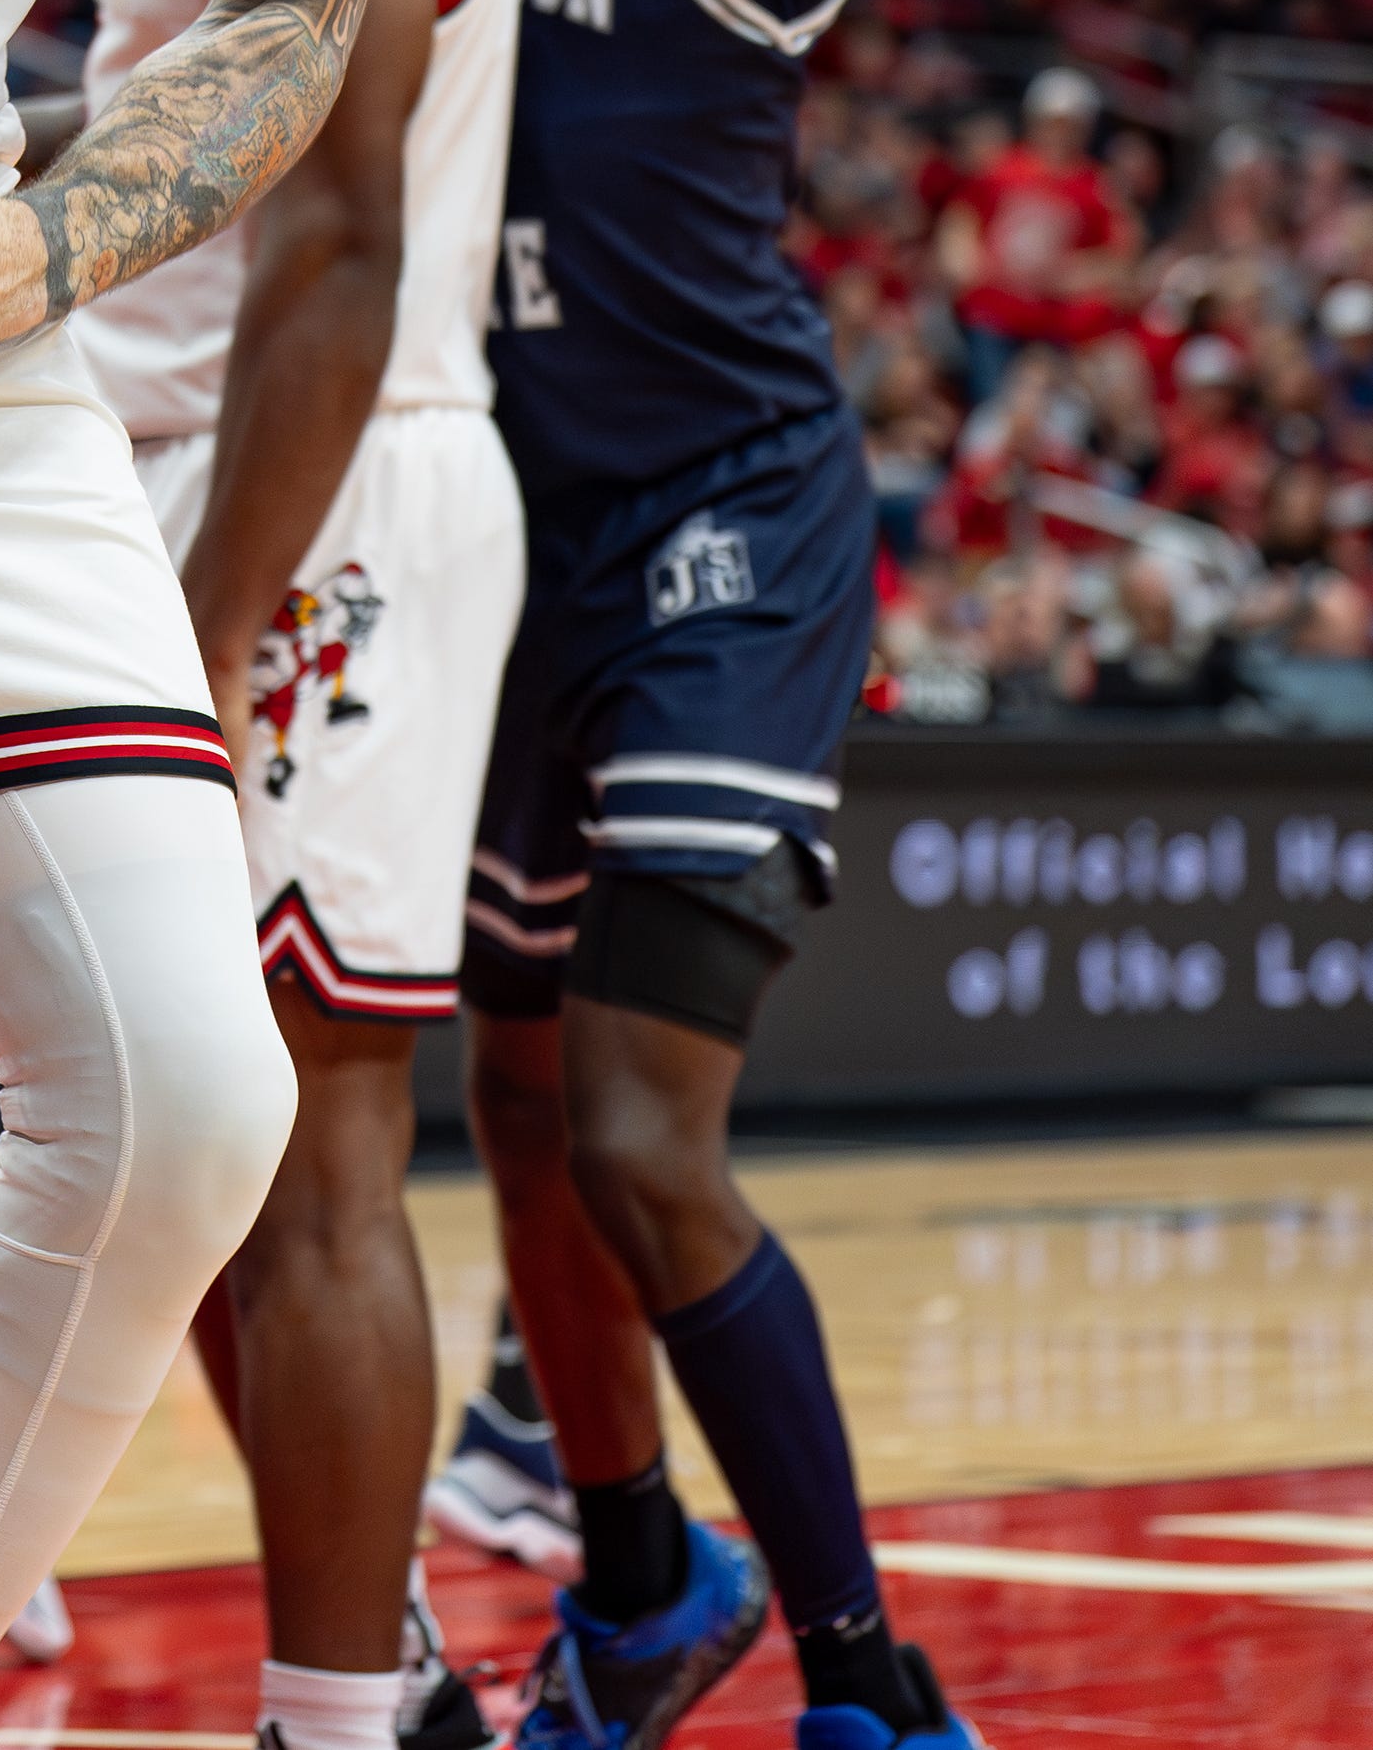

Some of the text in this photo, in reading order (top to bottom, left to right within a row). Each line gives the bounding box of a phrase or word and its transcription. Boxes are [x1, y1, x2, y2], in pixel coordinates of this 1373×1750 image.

[890, 815, 1246, 910] Official
[947, 922, 1373, 1019] of the Lo
